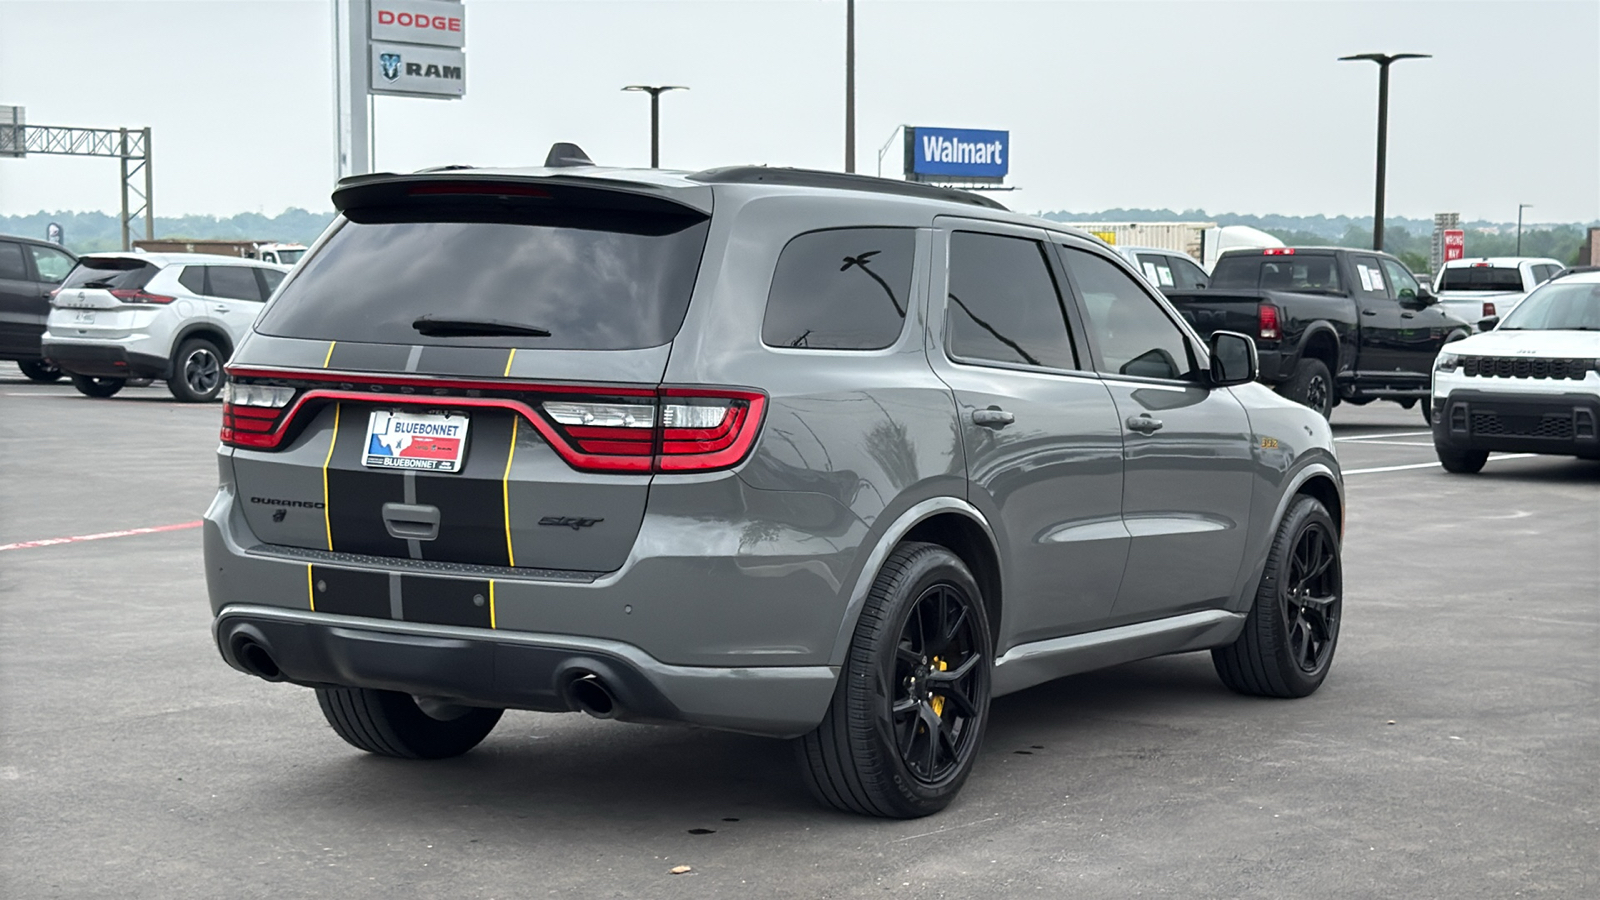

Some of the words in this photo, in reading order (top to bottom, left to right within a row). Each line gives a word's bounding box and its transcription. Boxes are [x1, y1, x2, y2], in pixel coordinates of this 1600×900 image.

[378, 10, 461, 32] DODGE
[405, 62, 461, 80] RAM
[923, 136, 1002, 165] Walmart
[394, 421, 459, 437] BLUEBONNET
[383, 457, 438, 469] BLUEBONNET
[250, 496, 325, 509] DURANGO
[538, 516, 605, 531] SRT
